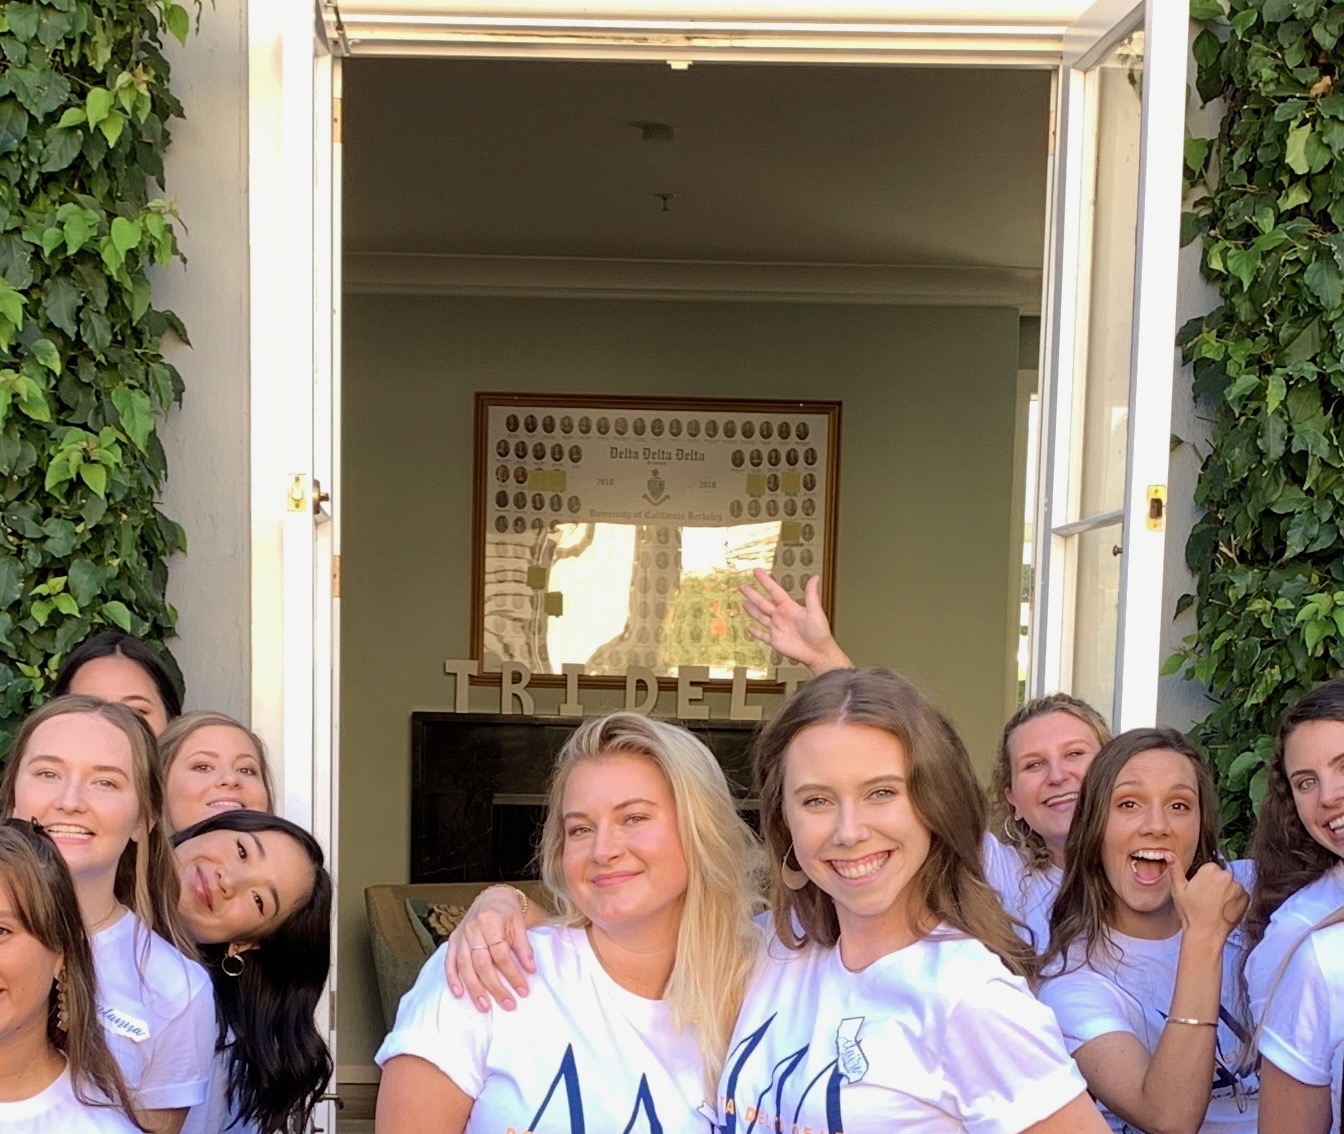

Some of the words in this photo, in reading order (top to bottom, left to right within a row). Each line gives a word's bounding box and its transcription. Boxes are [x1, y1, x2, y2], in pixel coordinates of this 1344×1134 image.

[609, 446, 639, 460] Delta
[642, 447, 673, 461] Delta
[675, 448, 706, 462] Delta
